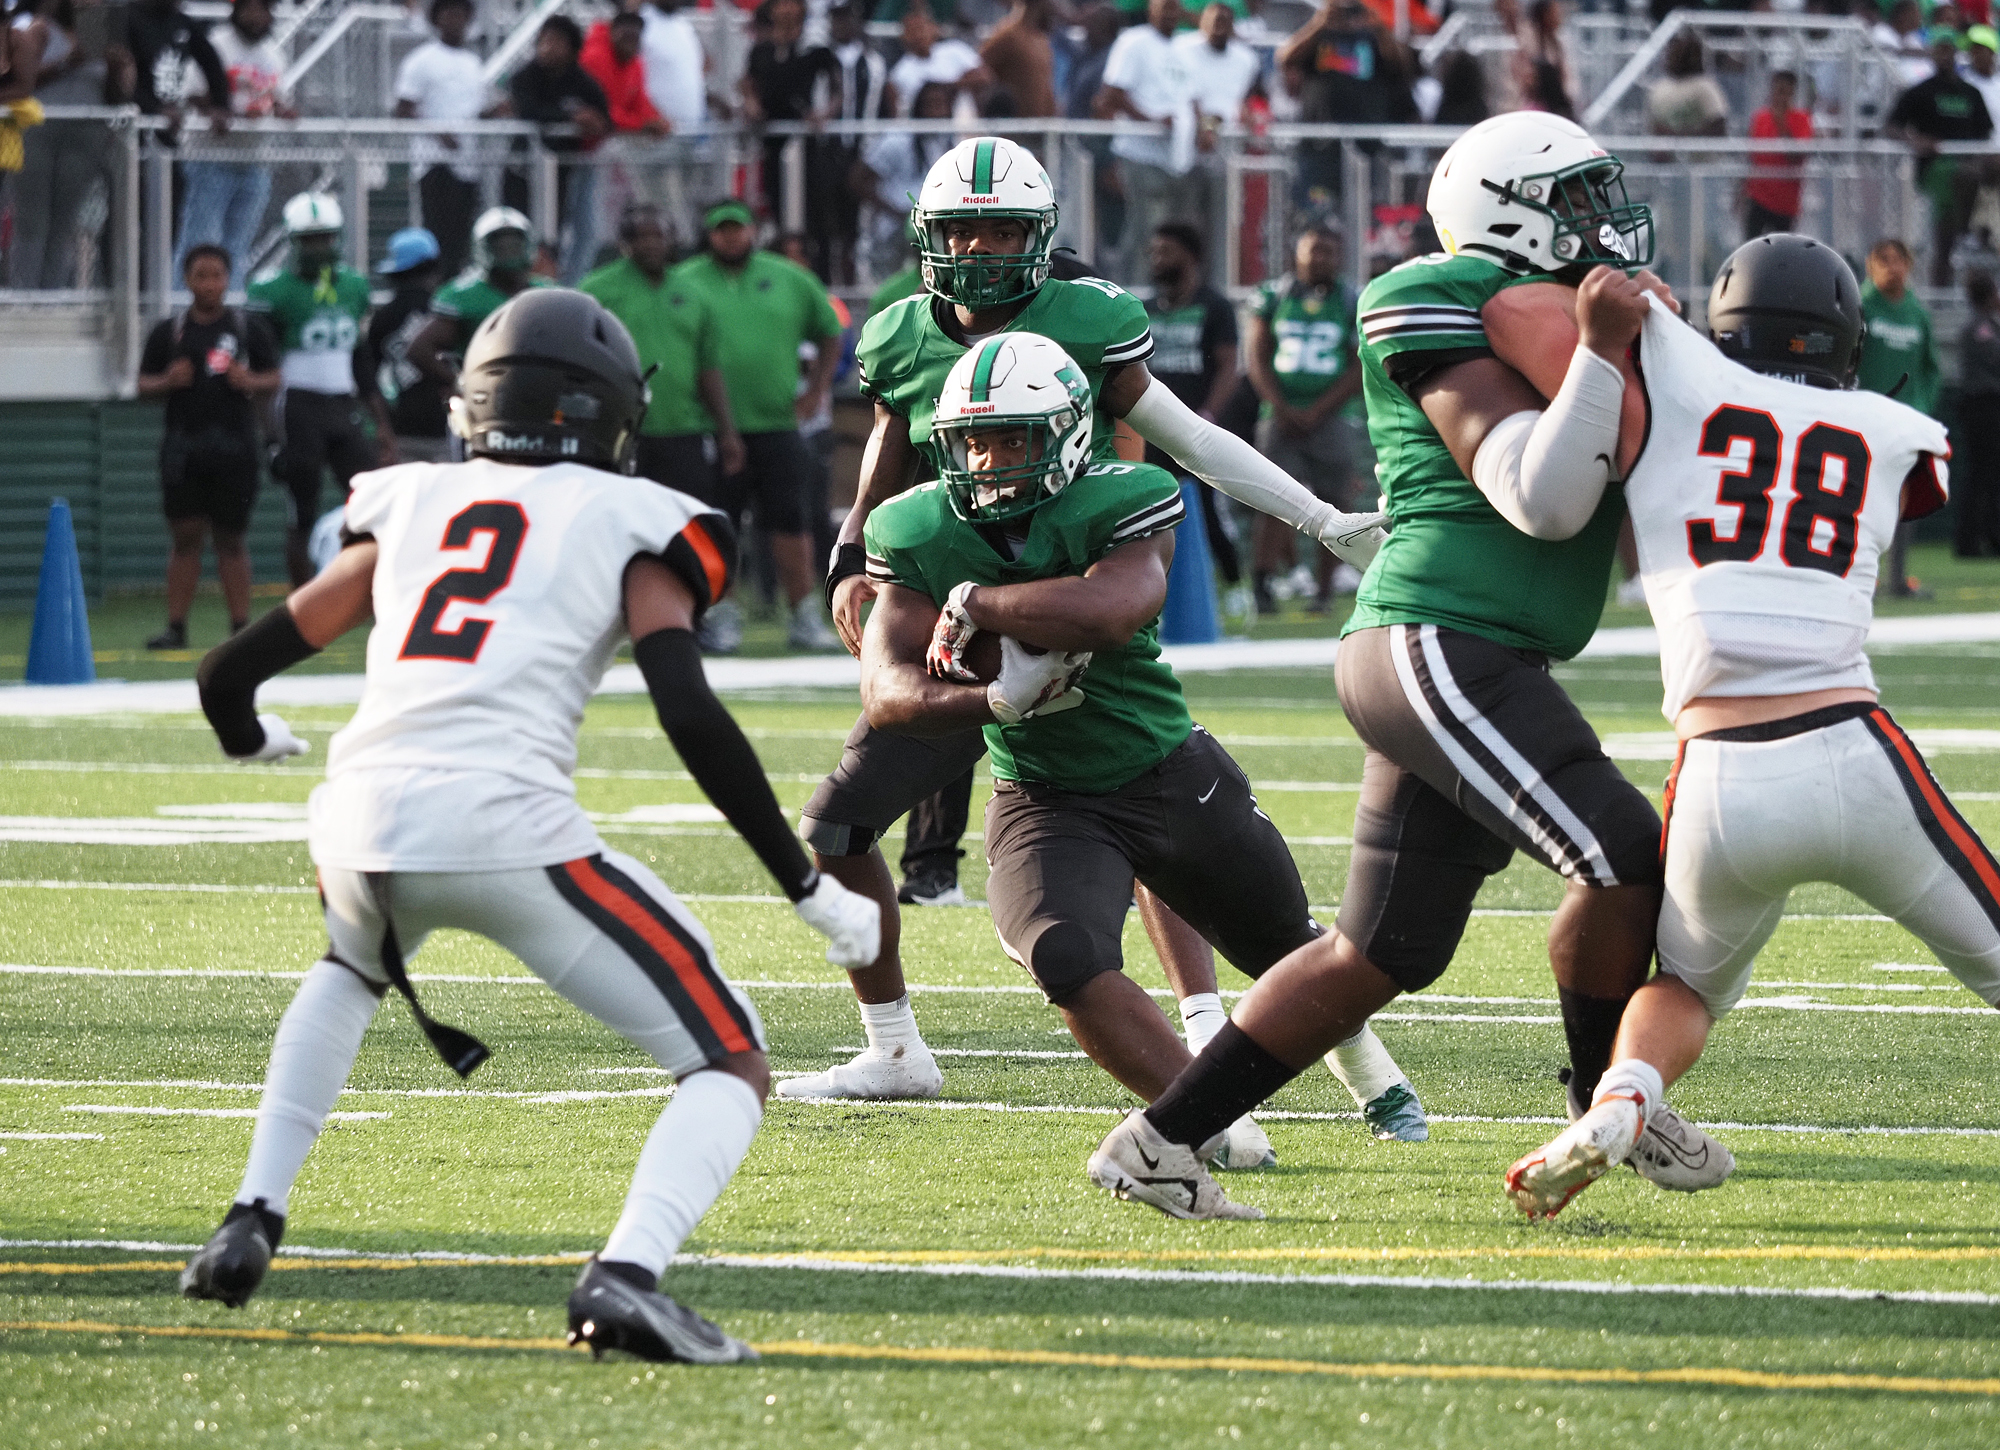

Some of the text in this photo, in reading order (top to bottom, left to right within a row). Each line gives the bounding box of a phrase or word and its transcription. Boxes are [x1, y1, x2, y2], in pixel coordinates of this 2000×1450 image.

[962, 196, 999, 204] Riddell
[960, 404, 995, 415] Riddell
[1686, 402, 1873, 580] 38
[396, 499, 531, 665] 2
